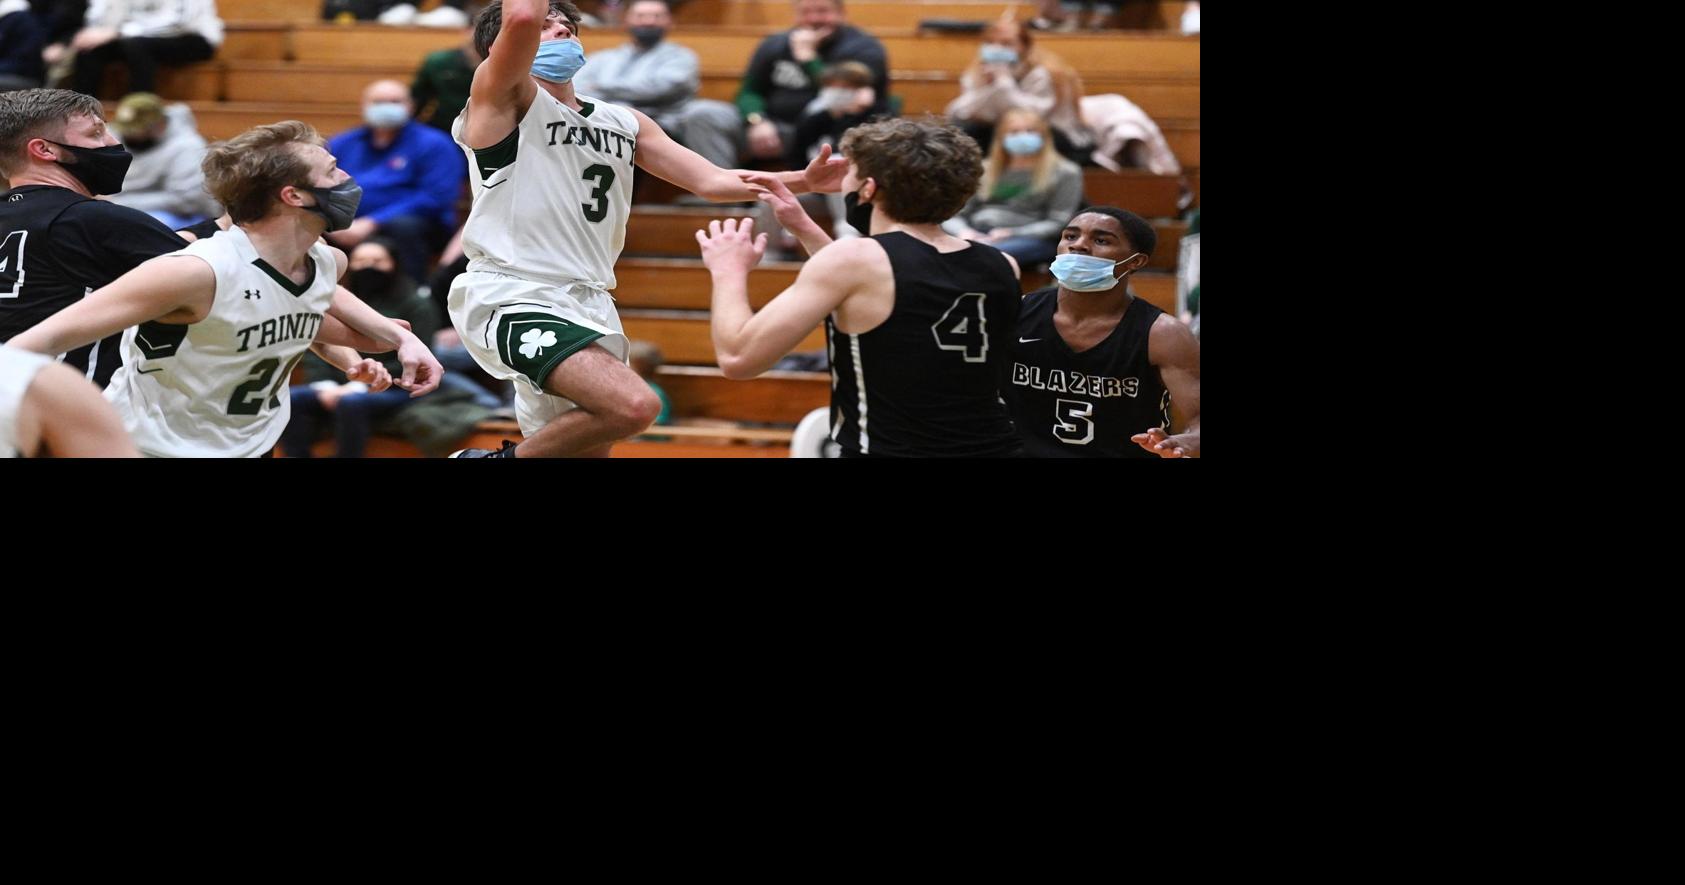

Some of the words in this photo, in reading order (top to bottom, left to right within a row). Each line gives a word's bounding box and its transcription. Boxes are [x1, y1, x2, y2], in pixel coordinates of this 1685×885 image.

[546, 121, 636, 167] TNITY
[582, 163, 616, 223] 3
[236, 312, 325, 353] TRINIT
[931, 292, 989, 363] 4
[1012, 362, 1140, 398] BLAZERS
[1053, 398, 1095, 445] 5
